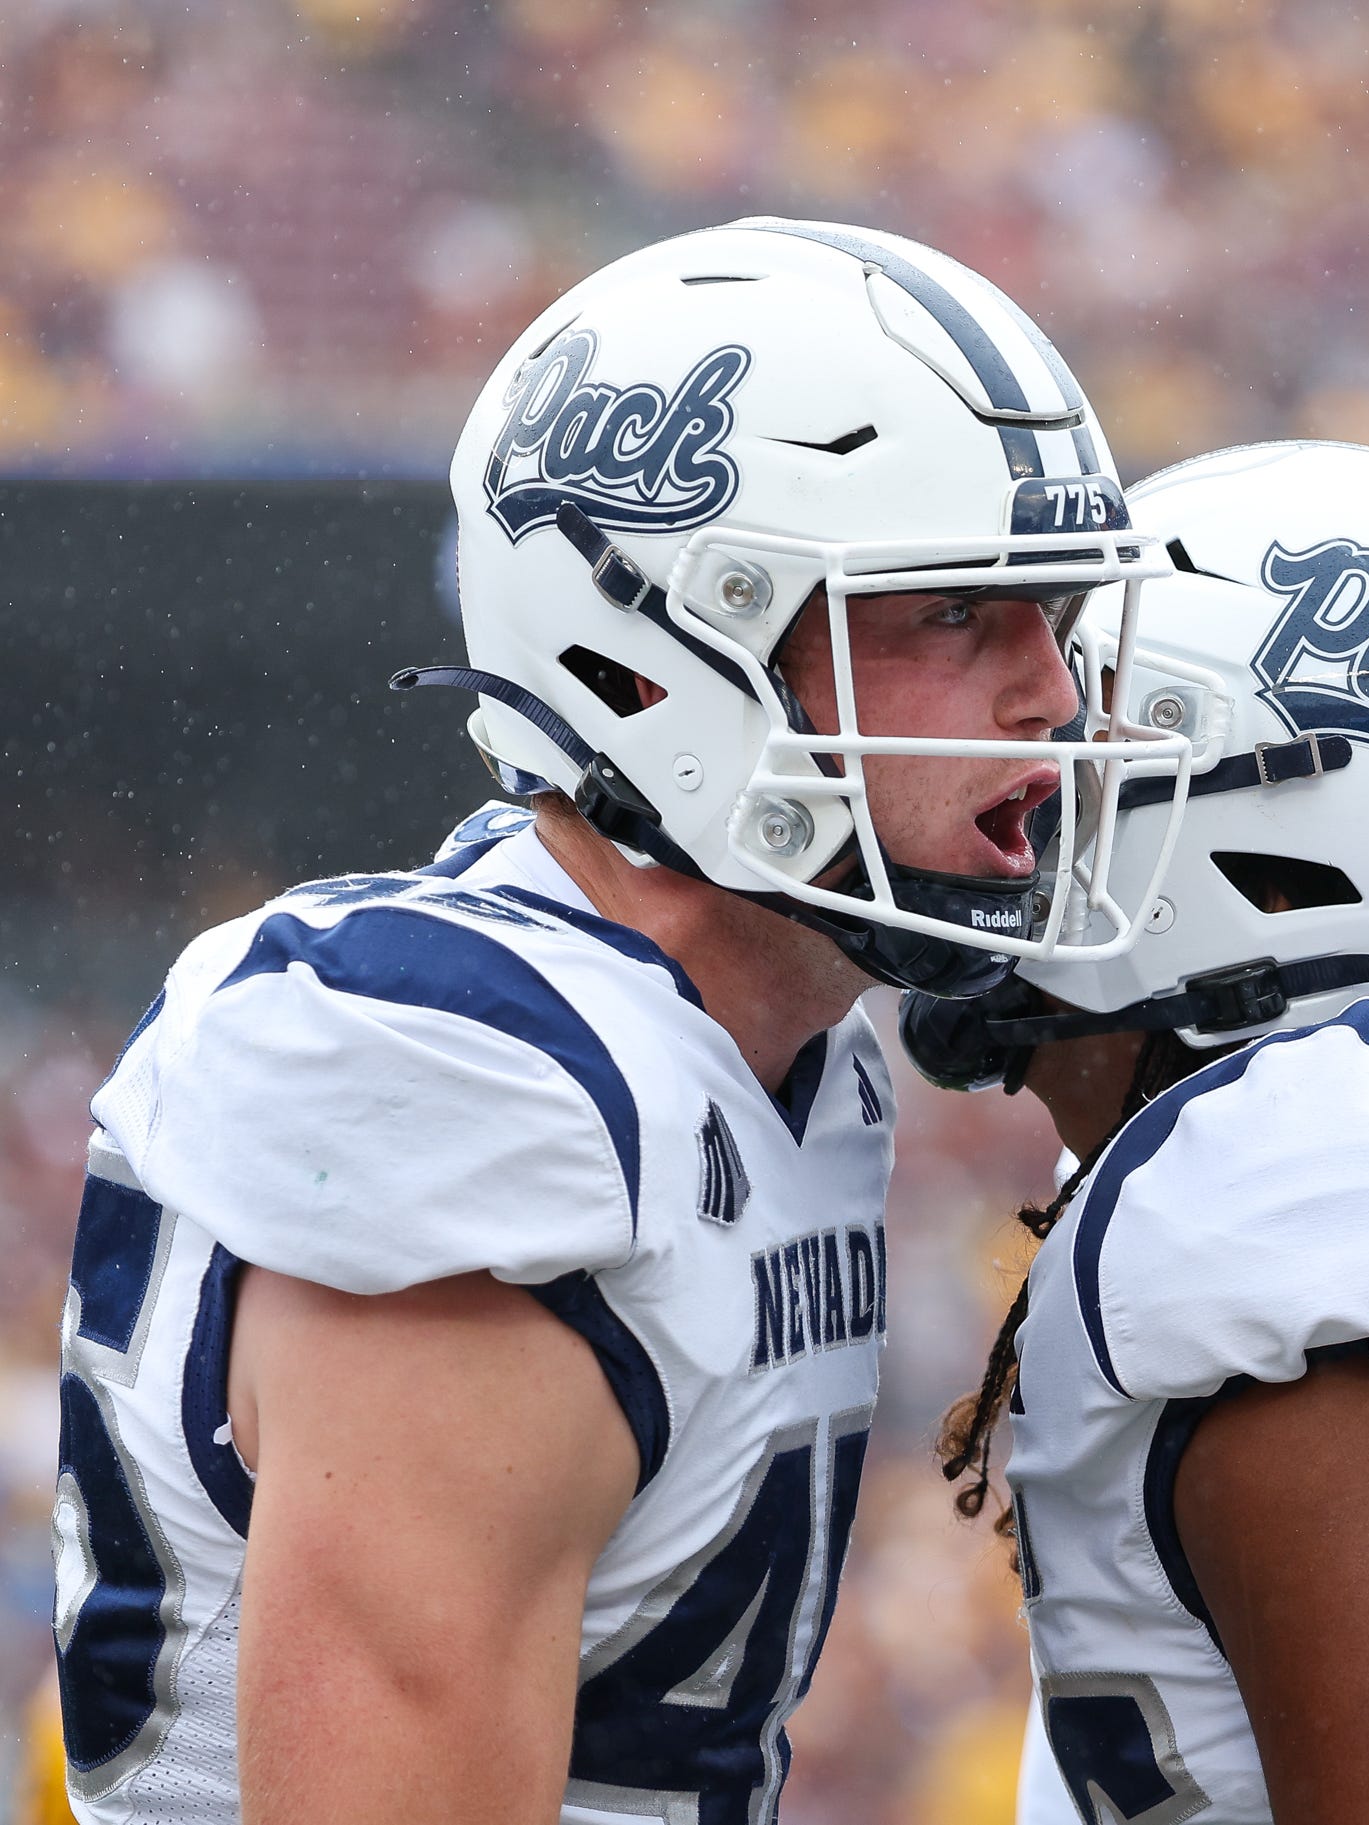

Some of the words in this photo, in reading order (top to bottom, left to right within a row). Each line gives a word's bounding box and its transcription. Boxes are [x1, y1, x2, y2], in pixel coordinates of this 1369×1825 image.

[483, 329, 755, 547] Pack
[1044, 482, 1107, 527] 775
[971, 909, 1022, 928] Riddell
